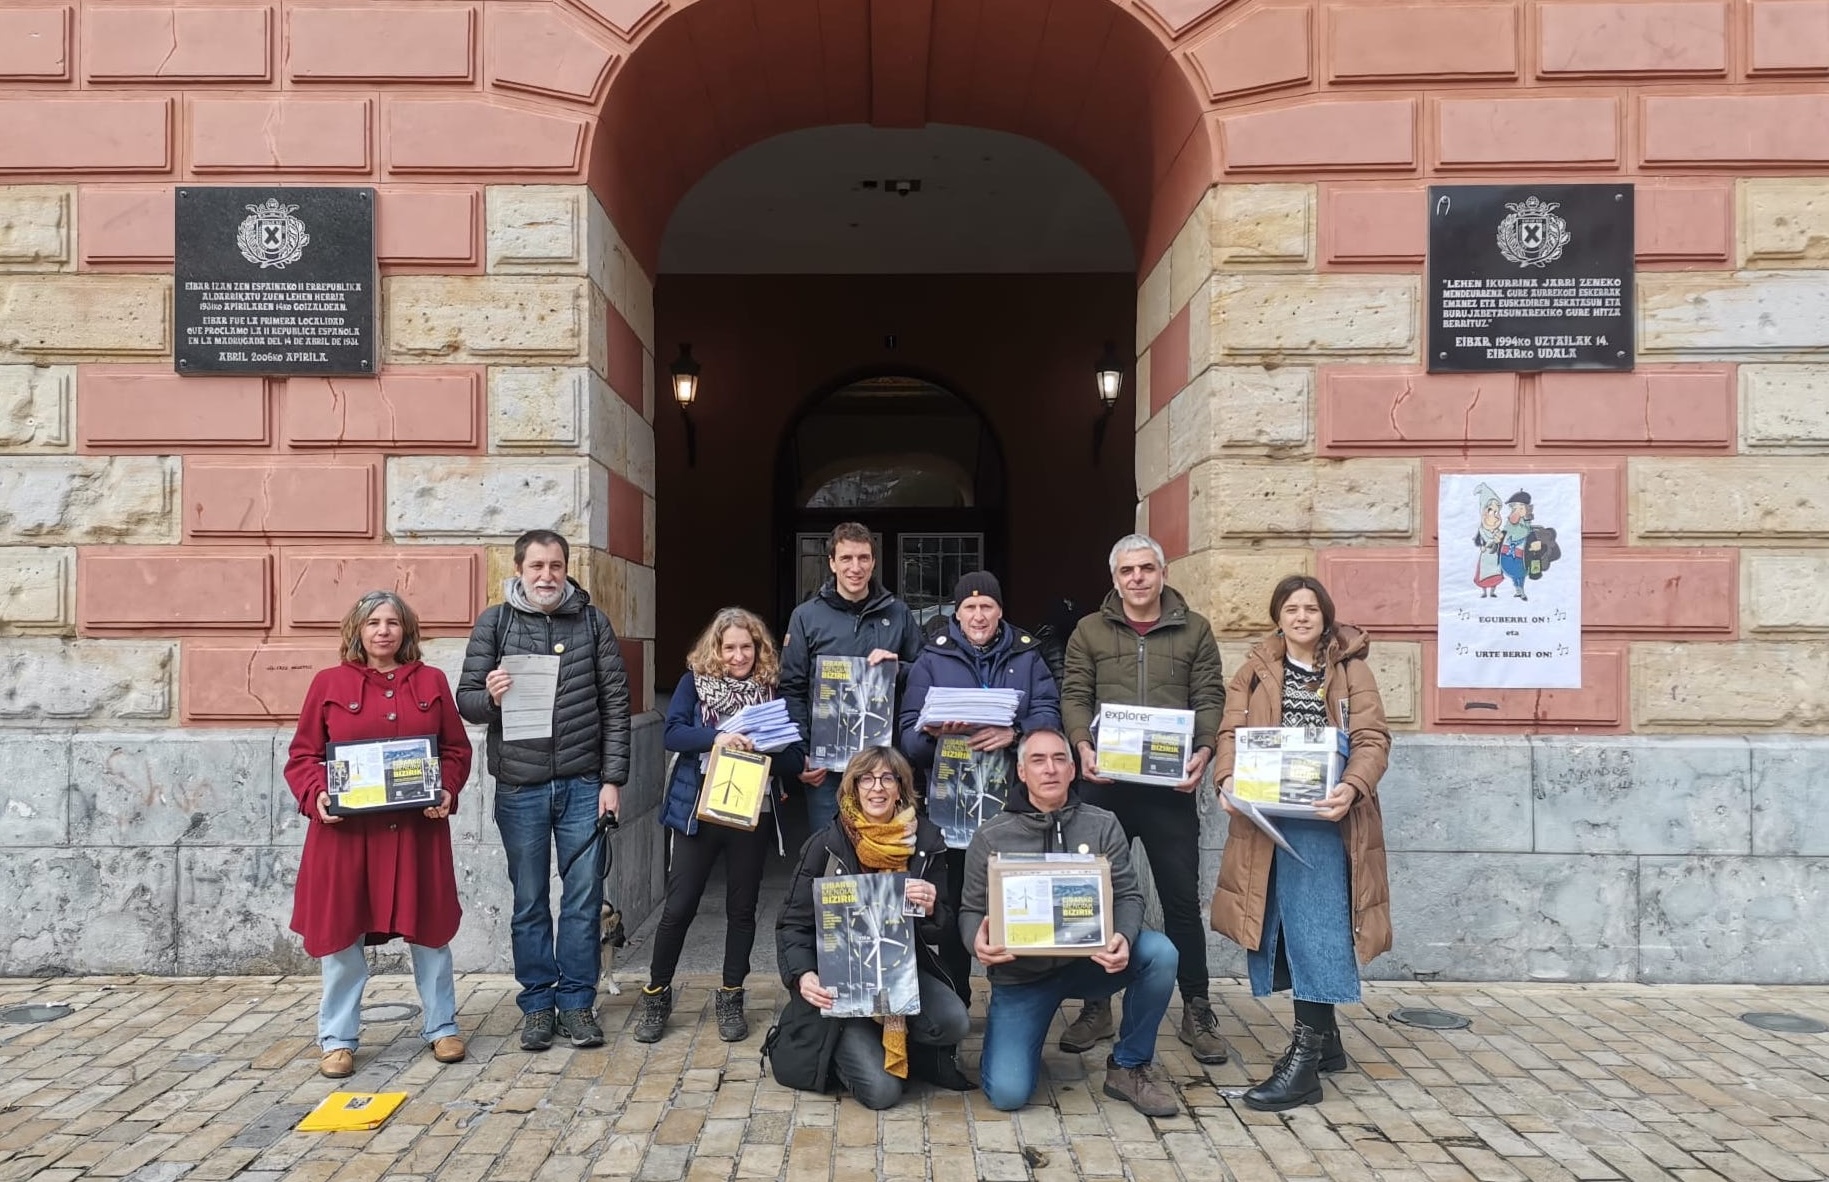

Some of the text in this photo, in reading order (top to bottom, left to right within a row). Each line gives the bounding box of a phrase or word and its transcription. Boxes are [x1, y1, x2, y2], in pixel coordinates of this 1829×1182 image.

[184, 282, 210, 291] EIBAR
[211, 282, 232, 291] IZAN
[233, 282, 250, 291] ZEN
[252, 282, 297, 291] ESPAINAKO
[305, 282, 362, 291] ERREPUBLIKA
[1542, 278, 1576, 287] JARRI
[1579, 278, 1622, 287] ZENEKO
[262, 292, 285, 301] ZUEN
[286, 292, 313, 301] LEHEN
[314, 292, 345, 301] HERRIA
[1506, 289, 1529, 297] GURE
[1578, 288, 1621, 297] ESKERRAK
[224, 303, 274, 311] APIRILAREN
[1442, 298, 1621, 307] EMANEZ ETA EUSKADIREN ASKATASUN ETA
[1565, 308, 1591, 317] GURE
[1592, 308, 1621, 317] HITZA
[202, 317, 345, 325] EIBAR FUE LA PRIMERA LOCALIDAD
[186, 327, 203, 335] QUE
[250, 327, 262, 335] LA
[188, 337, 199, 345] EN
[200, 337, 212, 345] LA
[214, 337, 265, 345] MADRUGADA
[267, 337, 283, 345] DEL
[284, 337, 292, 345] 14
[293, 337, 305, 345] DE
[305, 337, 330, 345] ABRIL
[331, 337, 342, 345] DE
[1534, 336, 1593, 346] UZTAILAK
[218, 352, 249, 362] ABRIL
[1537, 348, 1577, 359] UDALA
[1478, 616, 1528, 624] EGUBERRI
[1505, 629, 1520, 637] eta
[1104, 710, 1154, 722] explorer
[822, 894, 858, 904] BIZIRIK
[1062, 909, 1094, 917] BIZIRIK
